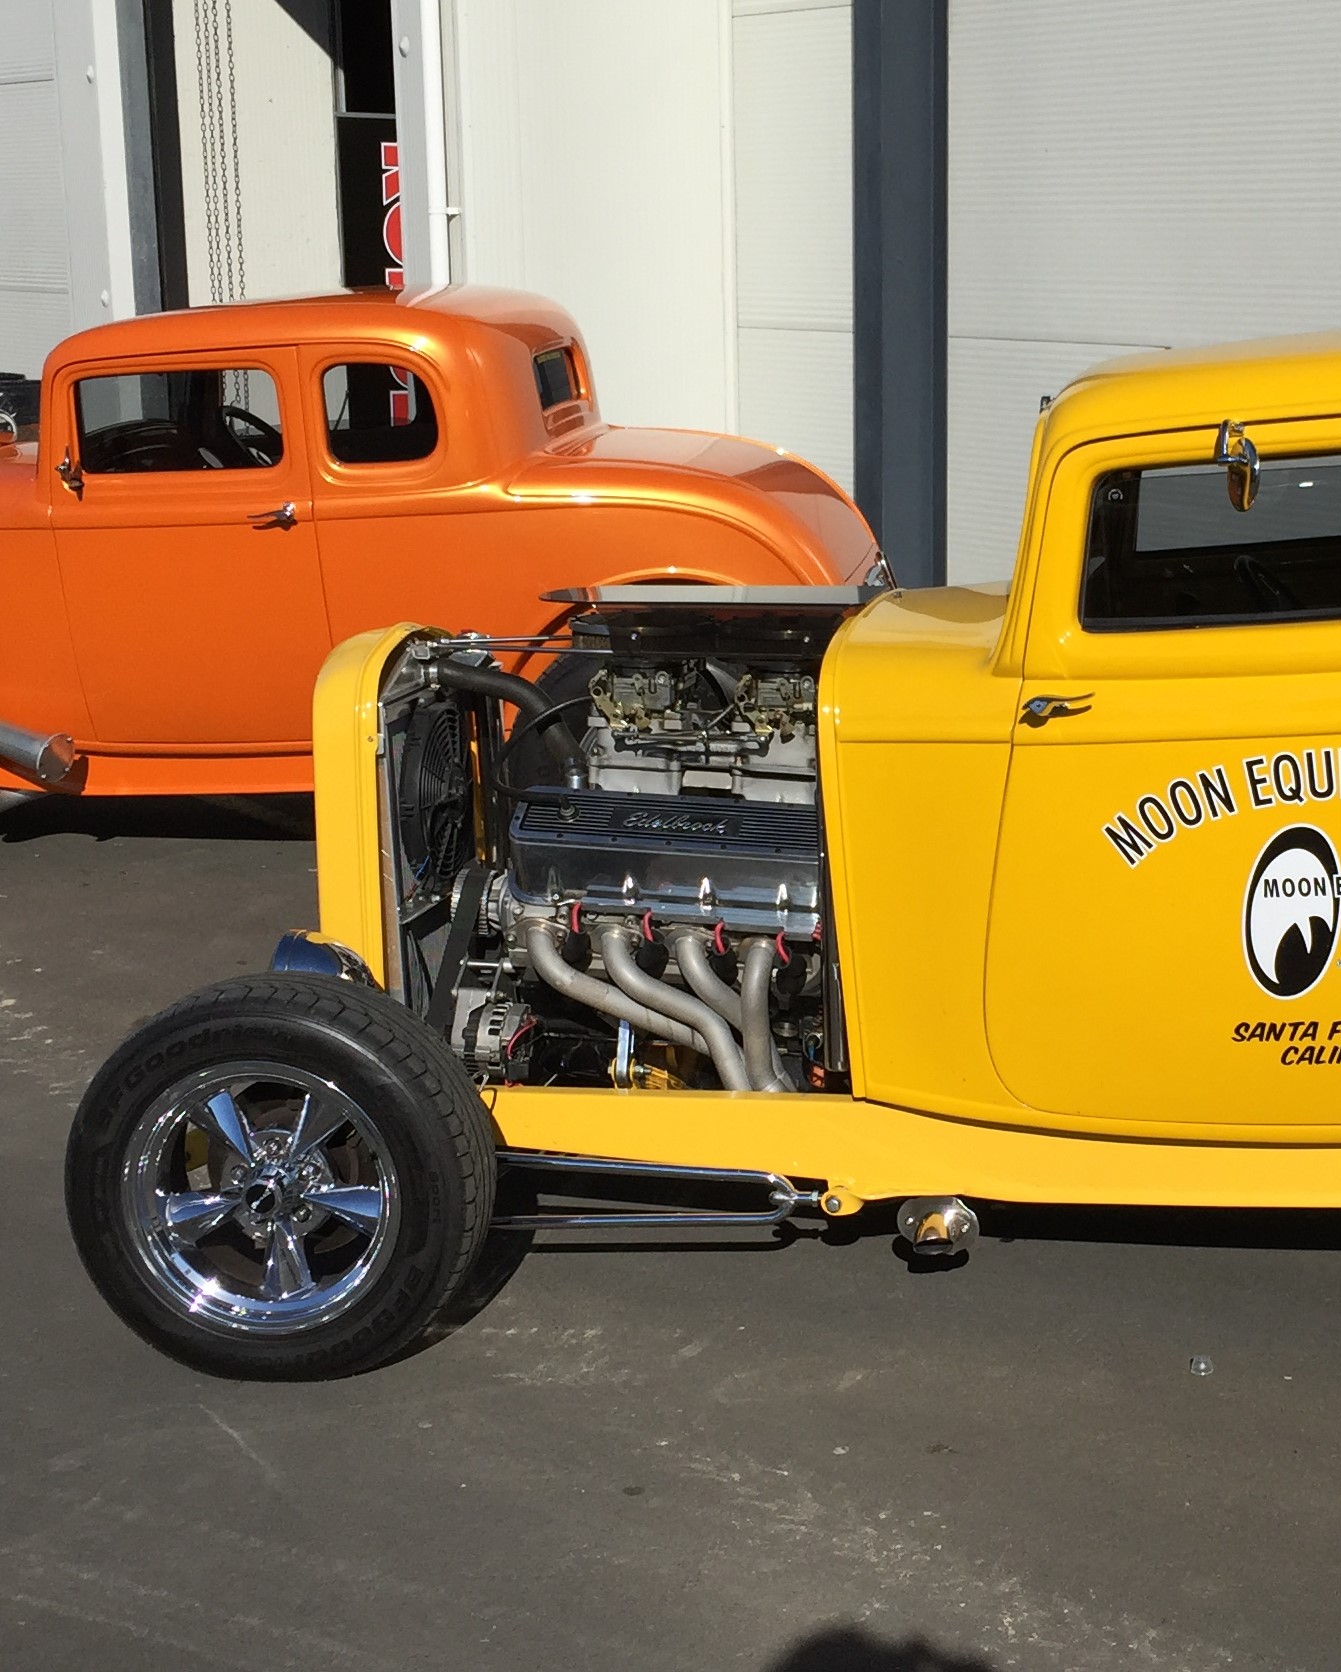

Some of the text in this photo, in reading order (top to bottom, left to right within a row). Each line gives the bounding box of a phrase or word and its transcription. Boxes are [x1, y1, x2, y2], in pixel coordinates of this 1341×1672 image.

[622, 811, 728, 836] Edelbrock
[1103, 767, 1237, 868] MOON
[1263, 876, 1327, 898] MOON
[1232, 1021, 1318, 1043] SANTA
